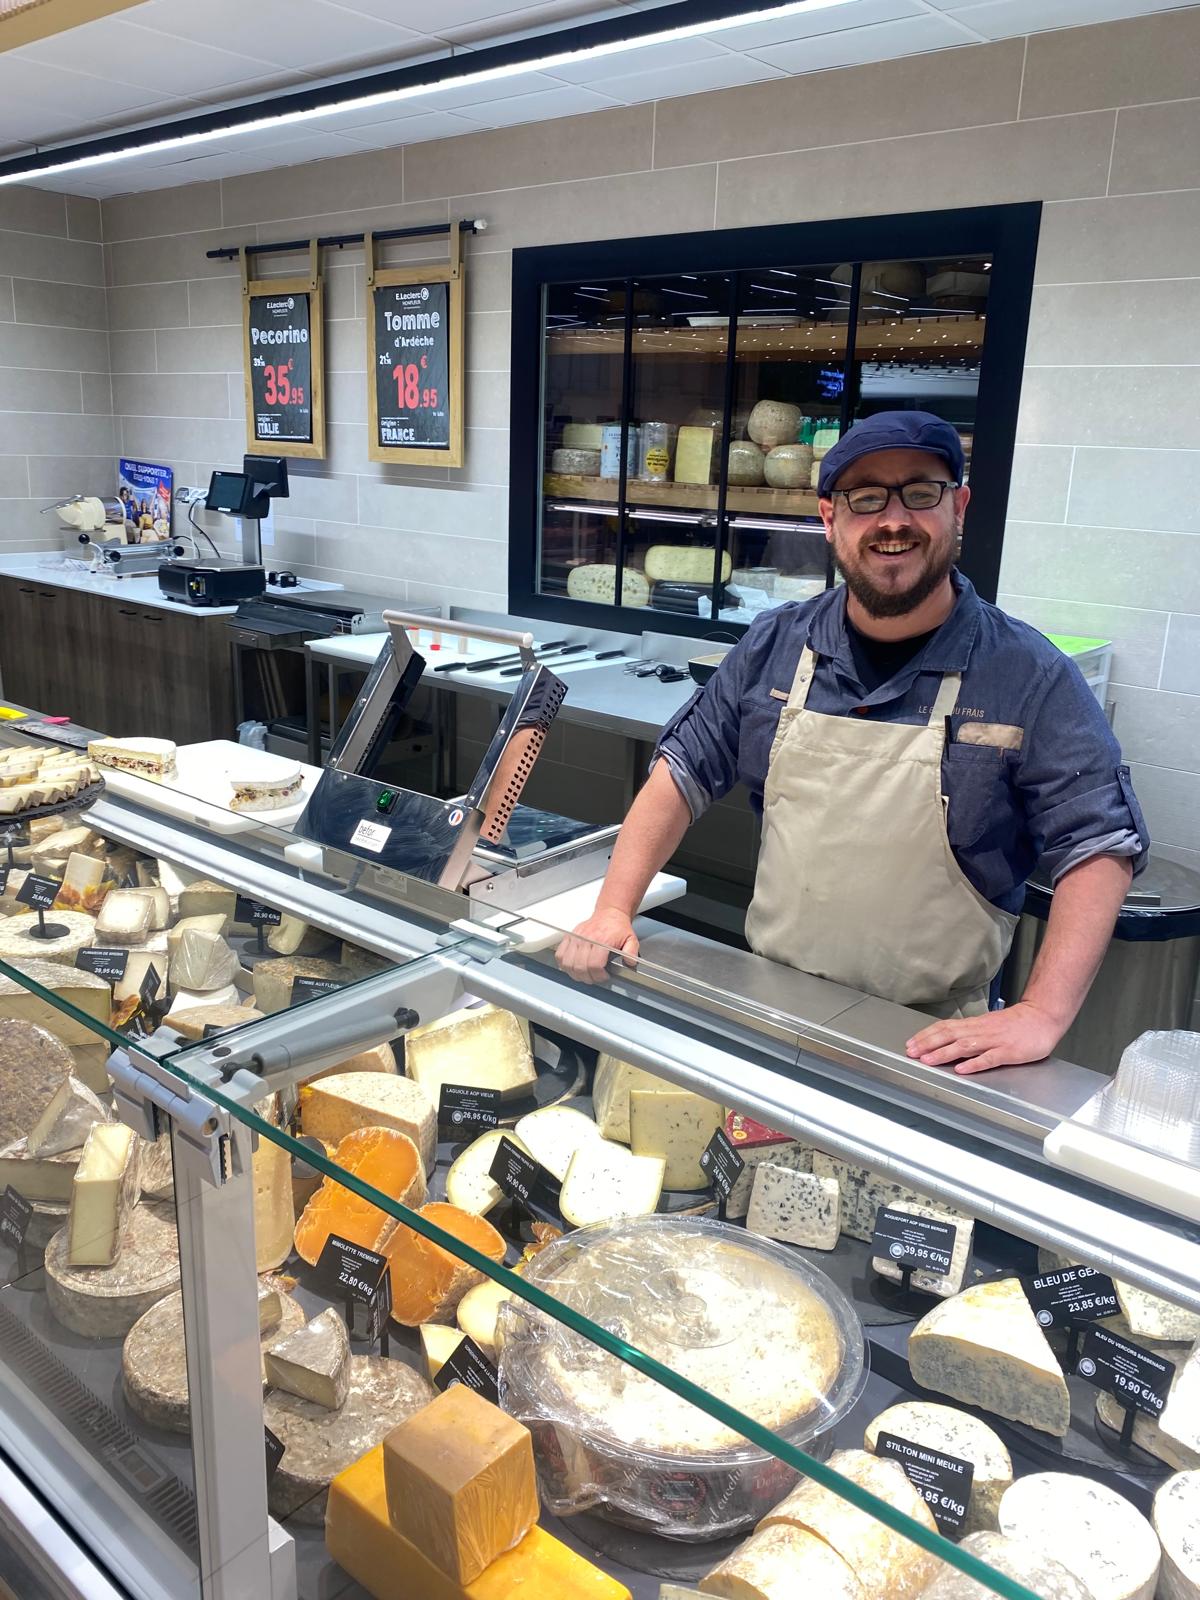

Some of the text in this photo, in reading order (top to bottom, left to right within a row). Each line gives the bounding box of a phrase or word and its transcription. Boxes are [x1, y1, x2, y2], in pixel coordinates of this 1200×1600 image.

[395, 291, 421, 300] E.Leclerc
[384, 312, 440, 331] Tomme
[251, 325, 308, 345] Pecorino
[257, 423, 279, 434] ITALIE
[381, 428, 415, 441] FRANCE
[918, 705, 927, 713] LE
[961, 707, 984, 718] FRAIS
[446, 1088, 469, 1096] LAGUIOLE
[463, 1111, 497, 1125] 26,95 €/kg
[884, 1213, 909, 1223] ROQUEFORT
[331, 1239, 358, 1255] MIMOLETTE
[904, 1245, 950, 1266] 39,95 €/kg
[339, 1272, 373, 1296] 22,80 €/kg
[1033, 1274, 1061, 1289] BLEU
[1062, 1271, 1077, 1283] DE
[1068, 1295, 1116, 1313] 23,85 €/kg
[1095, 1331, 1107, 1341] BLEU
[1107, 1337, 1115, 1345] DU
[1115, 1342, 1137, 1357] VERCORS
[1114, 1374, 1164, 1409] 19,90 €/kg
[886, 1440, 964, 1474] STILTON MINI MEULE
[940, 1497, 965, 1516] €/kg
